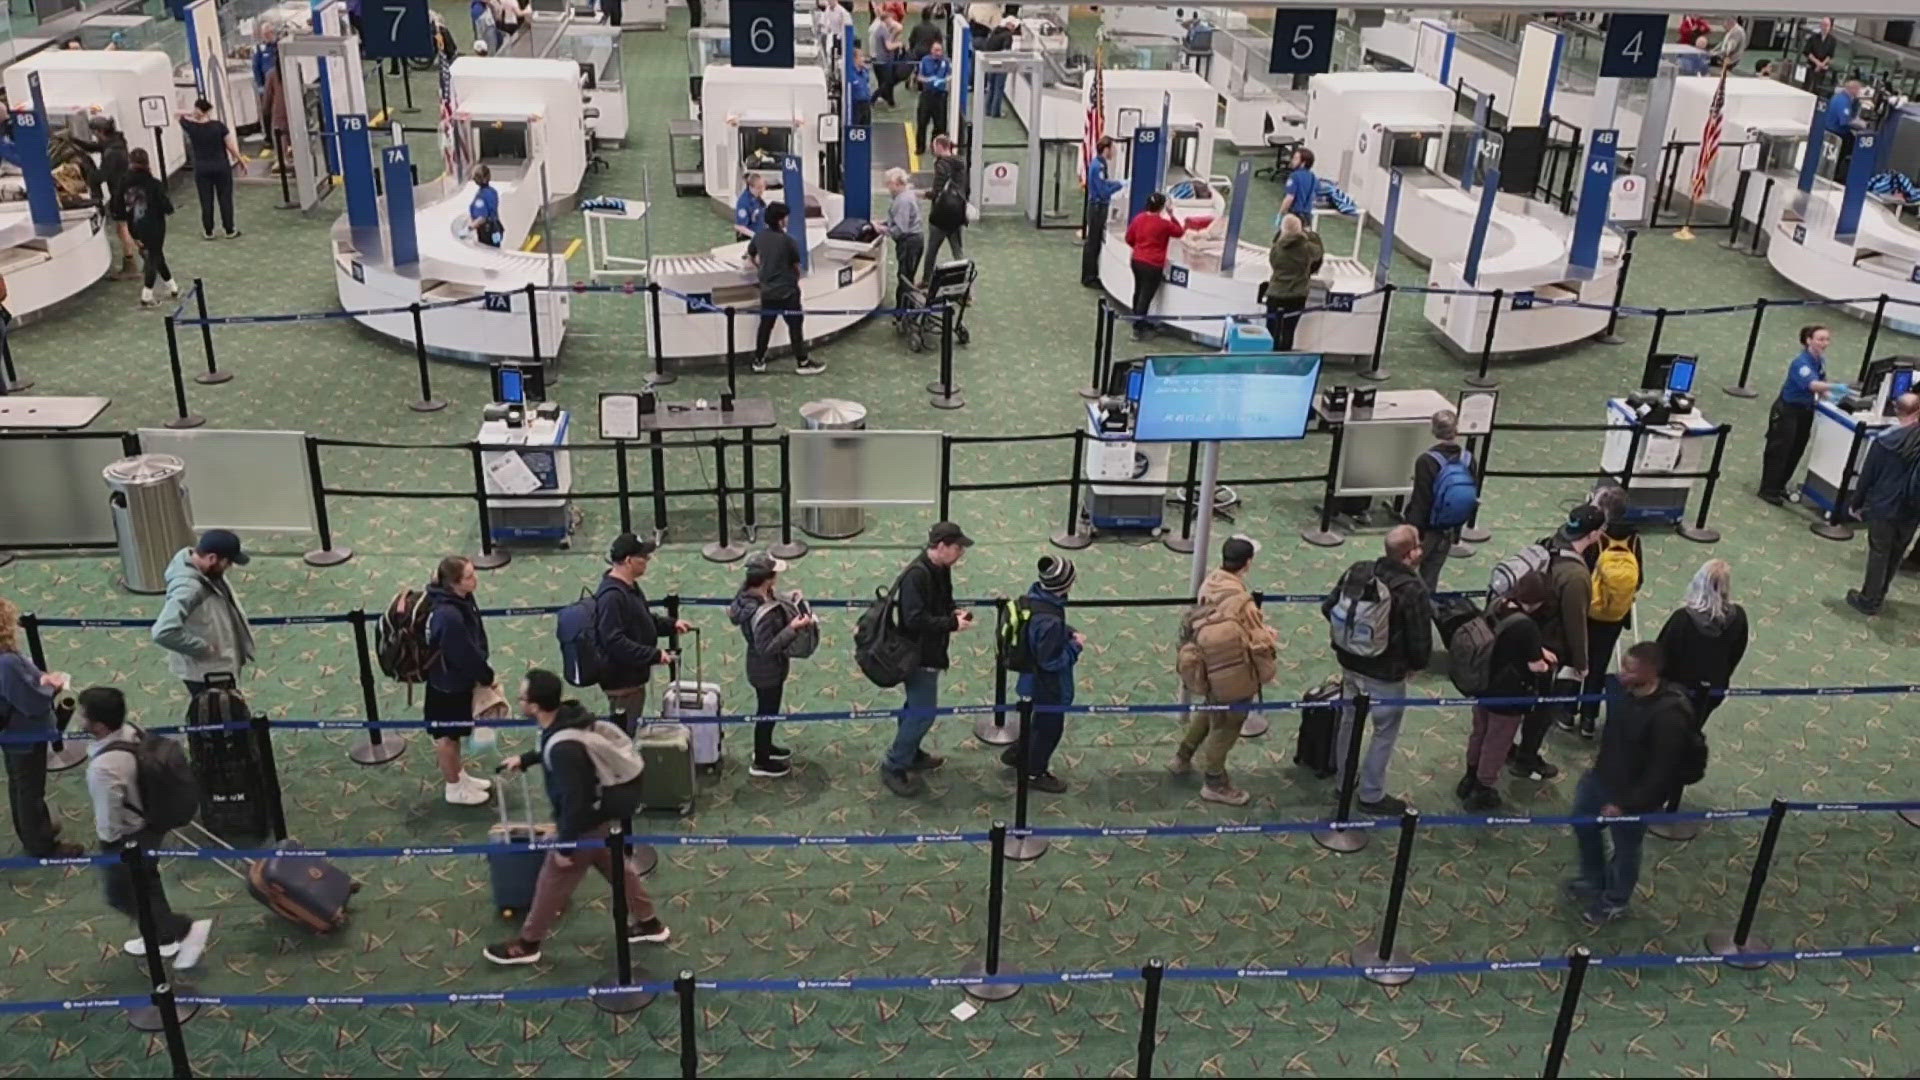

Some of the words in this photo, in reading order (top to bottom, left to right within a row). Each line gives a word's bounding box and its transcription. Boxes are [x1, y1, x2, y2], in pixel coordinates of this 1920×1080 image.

[382, 6, 404, 40] 7
[751, 17, 775, 53] 6
[1291, 25, 1315, 60] 5
[1622, 30, 1644, 64] 4
[343, 118, 361, 130] 7B
[849, 128, 866, 141] 6B
[1139, 131, 1155, 143] 5B
[1597, 133, 1612, 144] 4B
[1859, 136, 1874, 148] 3B
[387, 150, 405, 164] 7A
[1592, 161, 1608, 174] 4A
[1172, 269, 1186, 283] 5B
[489, 294, 507, 309] 7A
